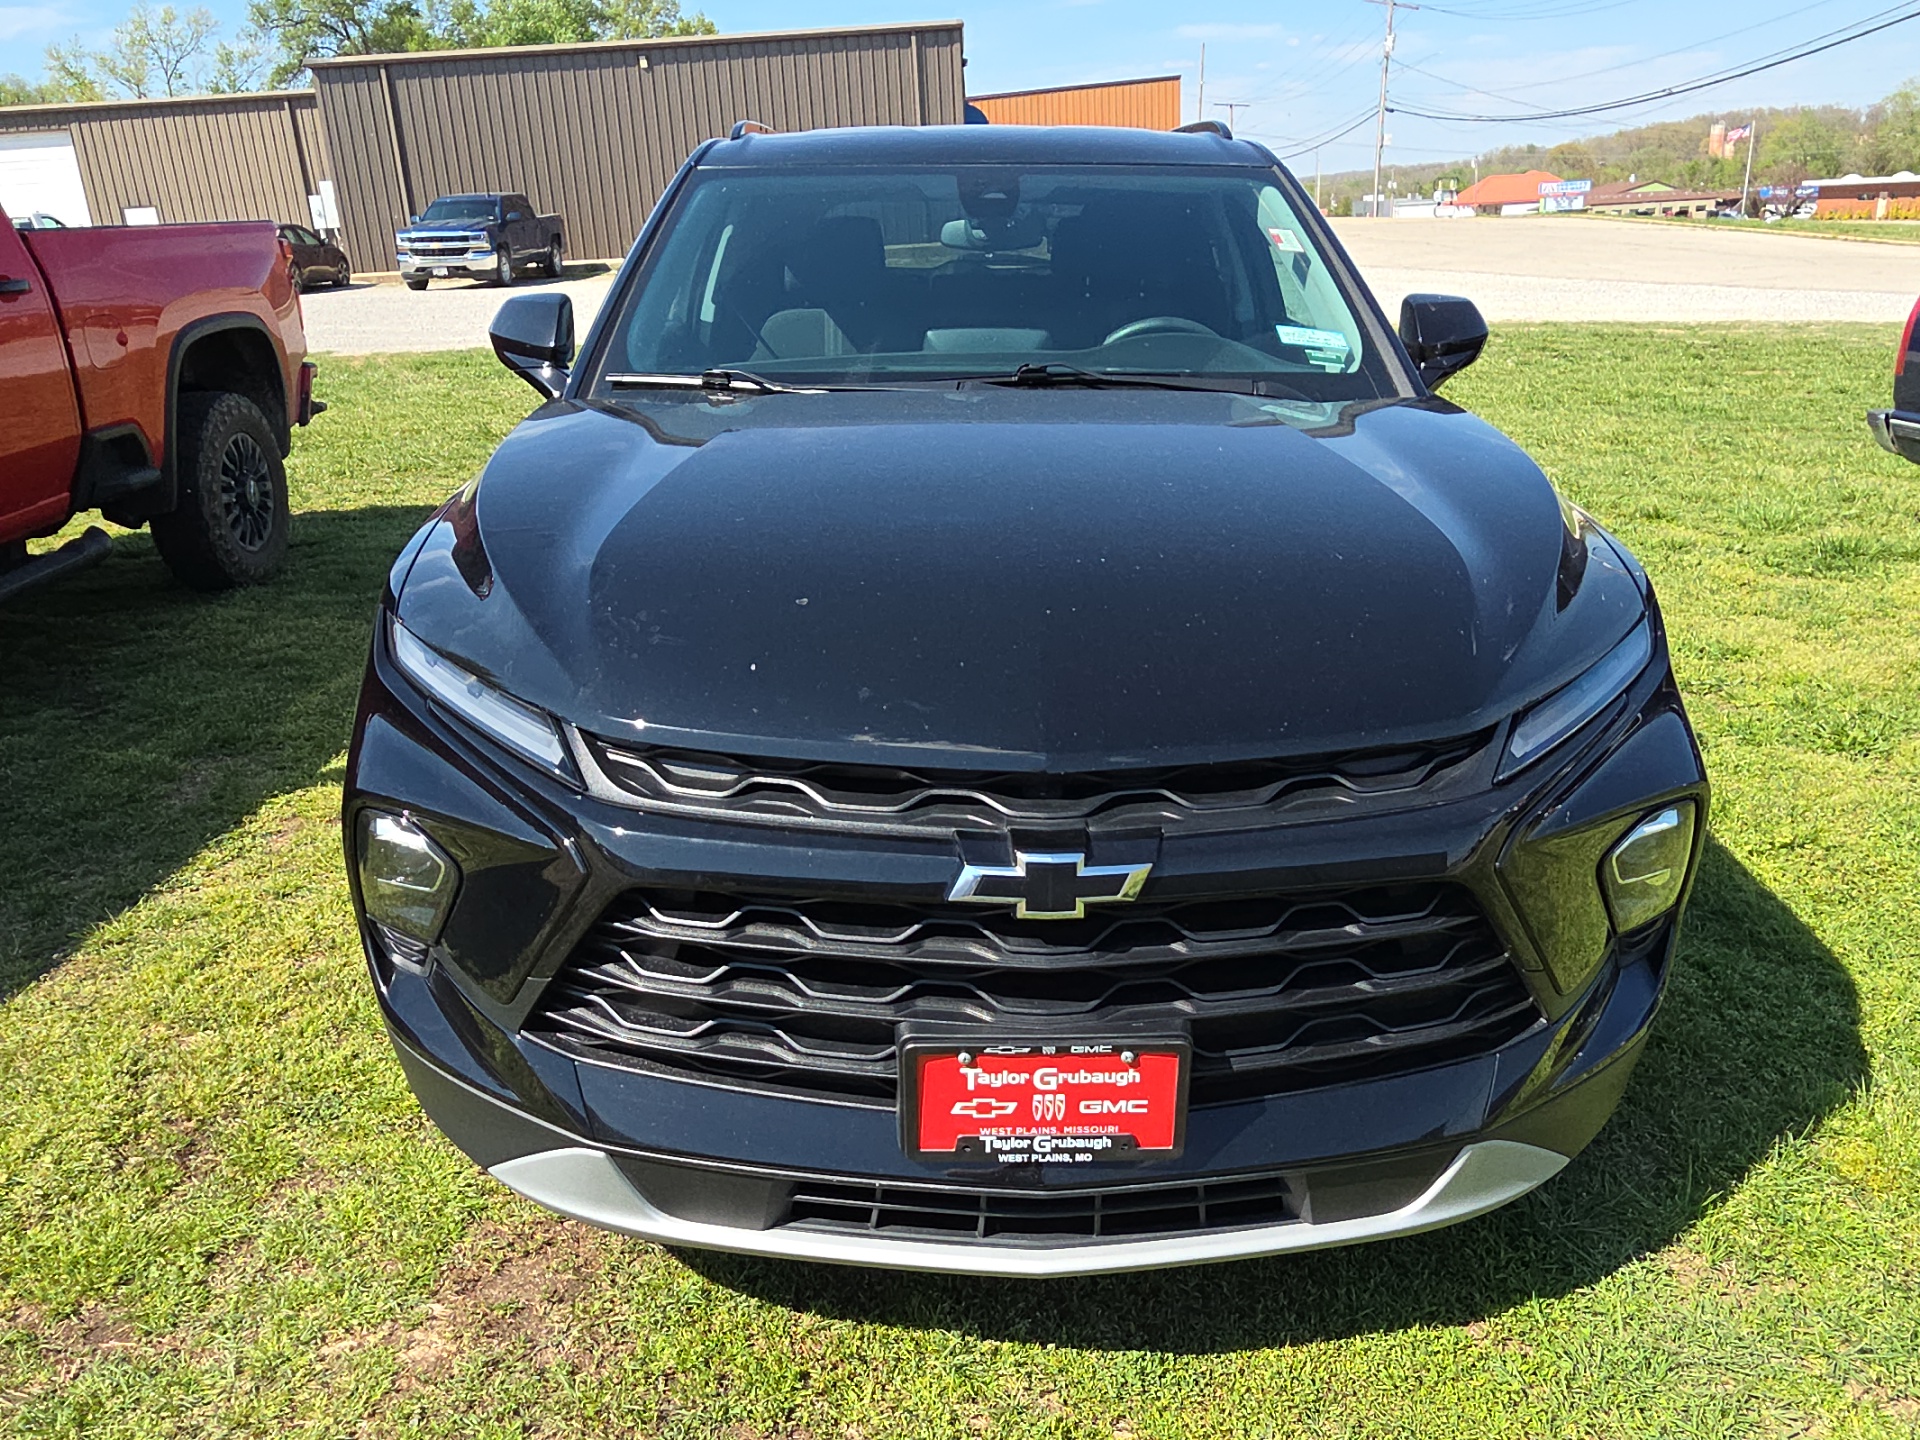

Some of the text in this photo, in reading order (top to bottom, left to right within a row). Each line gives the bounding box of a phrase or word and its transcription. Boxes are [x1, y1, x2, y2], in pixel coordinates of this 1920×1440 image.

[1070, 1045, 1112, 1053] GMC
[959, 1067, 1140, 1090] Taylor Grubaugh
[1079, 1100, 1148, 1113] GMC
[980, 1127, 1012, 1135] WEST
[1064, 1125, 1118, 1133] MISSOURI
[979, 1135, 1111, 1153] Taylor Grubaugh
[998, 1153, 1093, 1163] WEST PLAINS, MO
